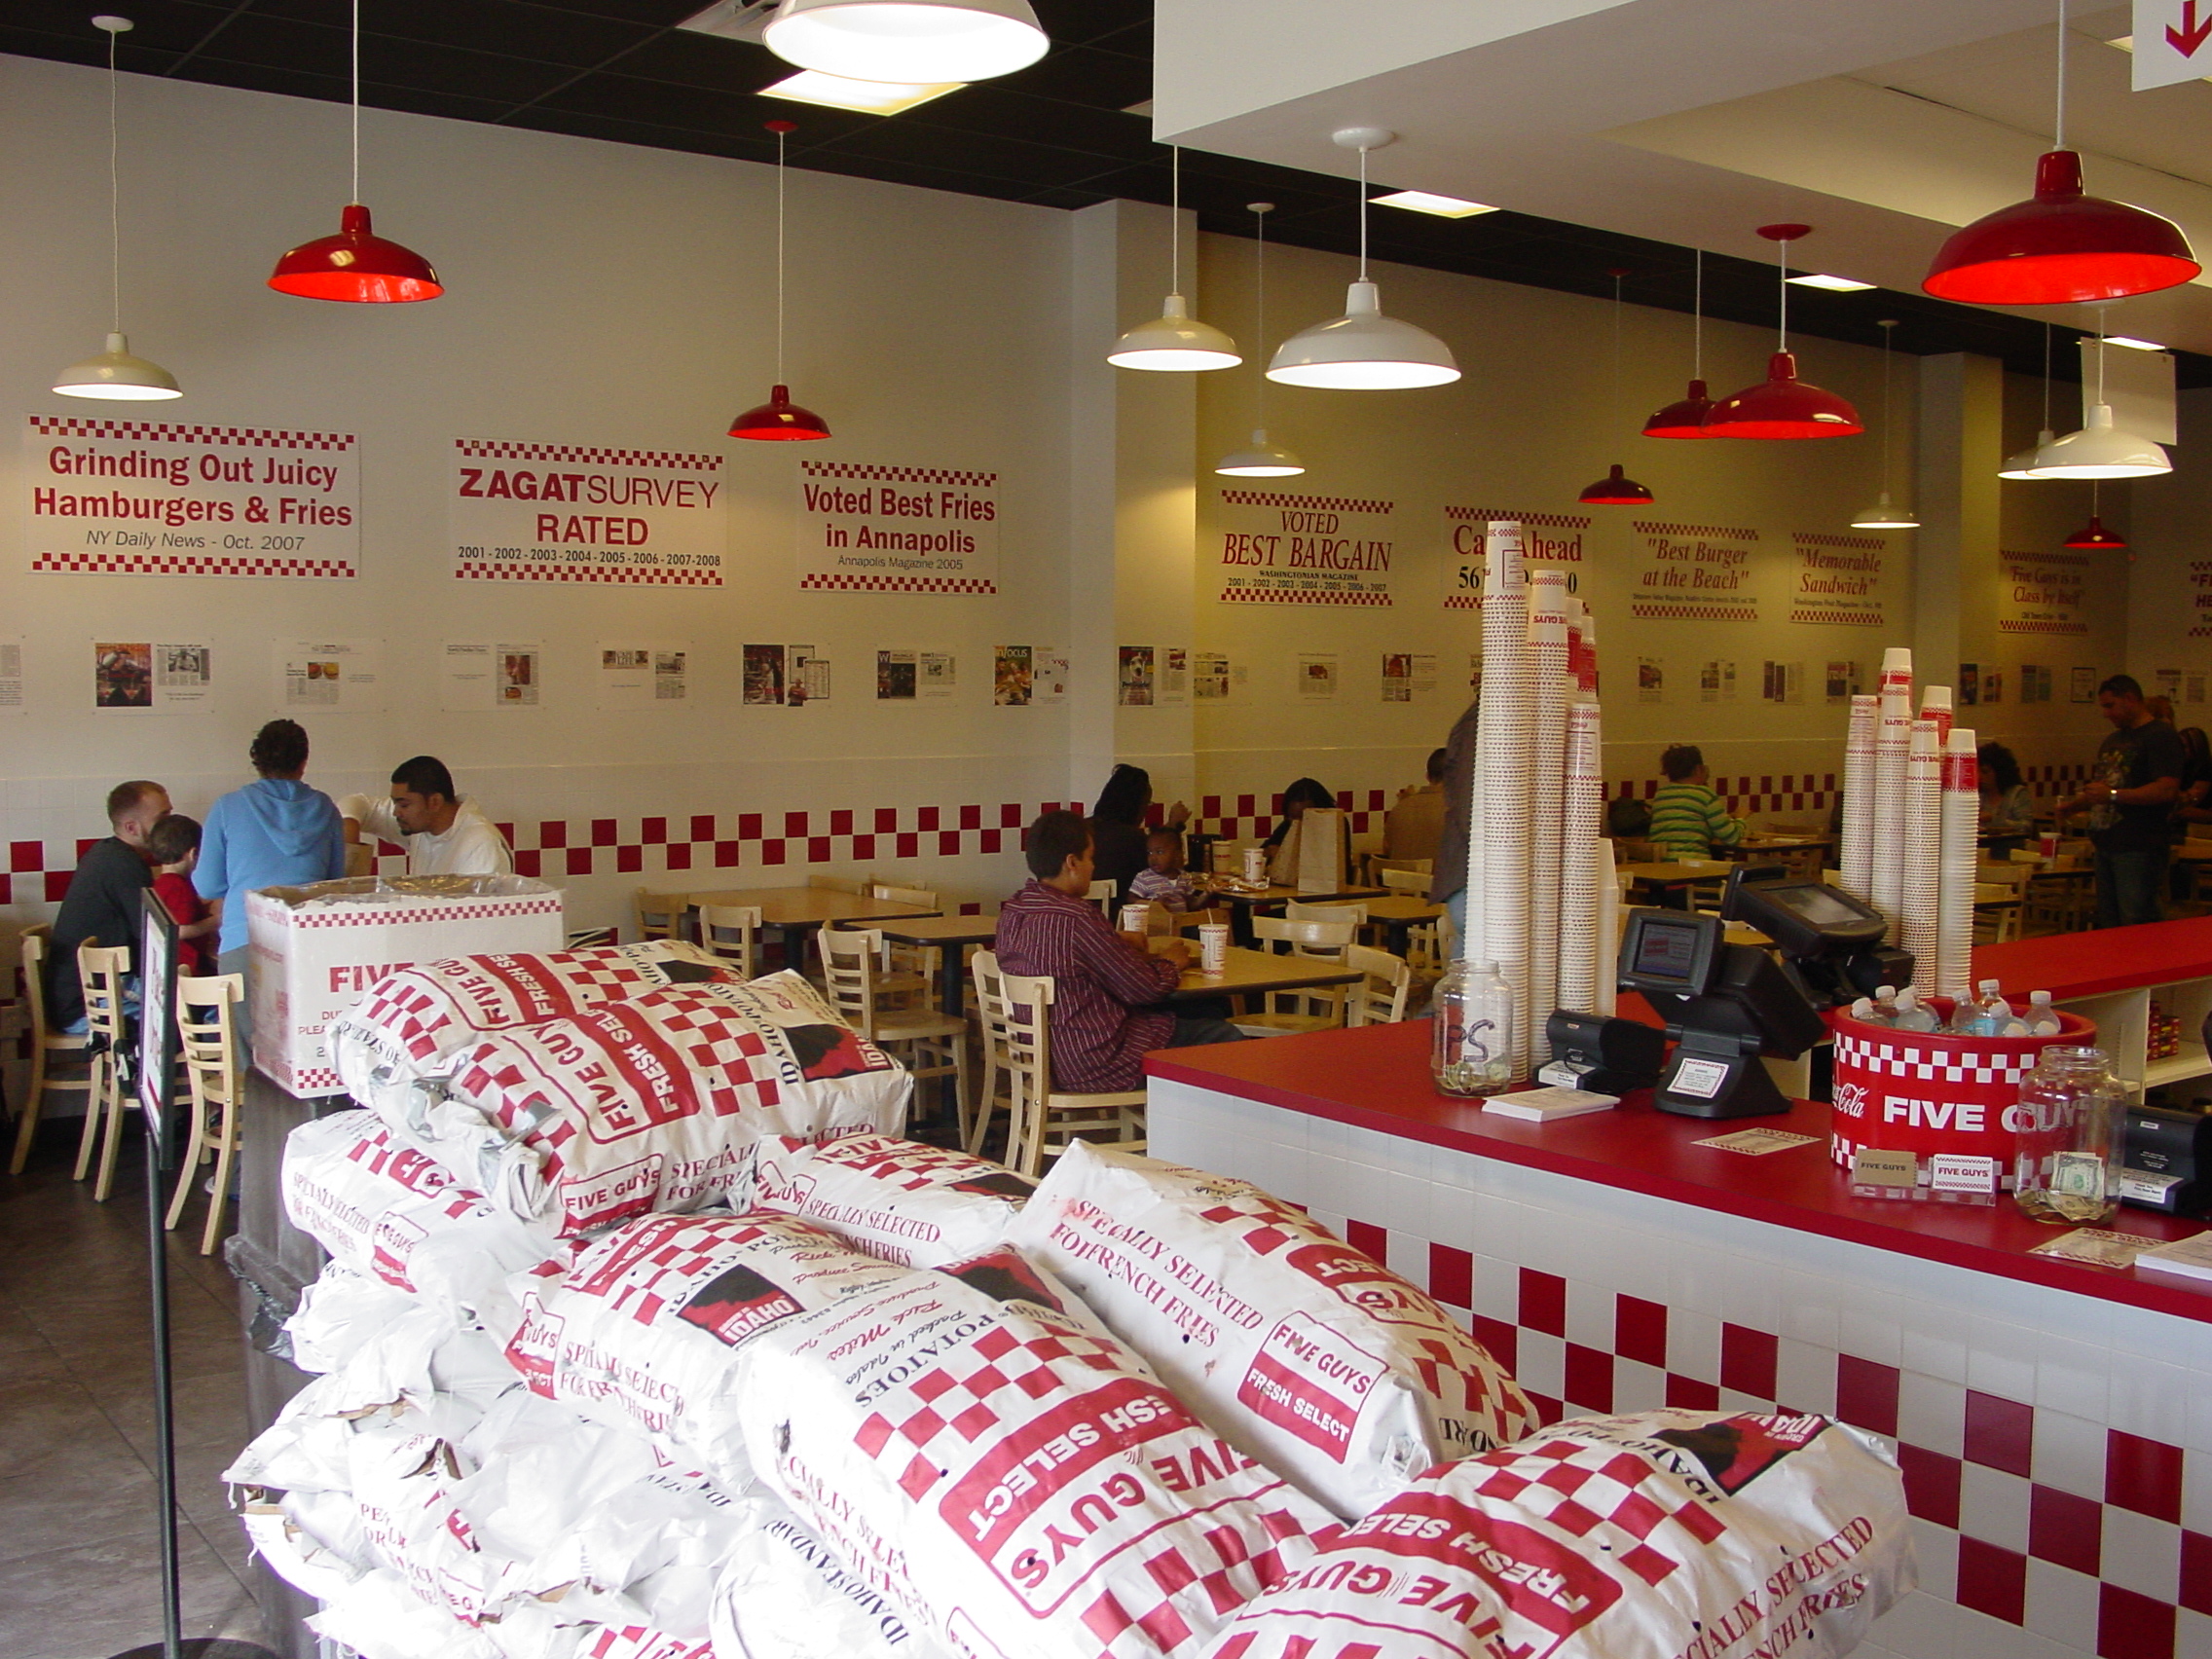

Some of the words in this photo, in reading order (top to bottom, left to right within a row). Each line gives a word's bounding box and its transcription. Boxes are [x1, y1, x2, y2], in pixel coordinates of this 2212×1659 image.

[49, 445, 191, 487] Grinding
[199, 454, 254, 484] Out
[262, 458, 339, 493] Juicy
[33, 487, 236, 527] Hamburgers
[243, 495, 270, 524] &
[278, 497, 352, 527] Fries
[802, 483, 872, 516] Voted
[880, 488, 934, 519] Best
[940, 491, 996, 522] Fries
[86, 530, 111, 546] NY
[115, 531, 156, 550] Daily
[161, 533, 206, 548] News
[222, 535, 254, 550] Oct.
[261, 535, 306, 551] 2007
[536, 513, 649, 546] RATED
[826, 523, 849, 548] in
[855, 525, 977, 557] Annapolis
[1280, 510, 1340, 535] VOTED
[1453, 524, 1487, 555] Ca
[458, 546, 485, 559] 2001
[494, 547, 522, 560] 2002
[531, 548, 558, 561] 2003
[566, 549, 592, 562] 2004
[599, 551, 626, 563] 2005
[633, 552, 659, 565] 2006
[837, 554, 886, 568] Annapolis
[888, 556, 935, 571] Magazine
[937, 558, 964, 570] 2005
[1222, 533, 1282, 567] BEST
[1288, 536, 1393, 571] BARGAIN
[1694, 541, 1749, 569] Burger
[1641, 570, 1659, 587] at
[1663, 566, 1687, 588] the
[329, 962, 415, 993] FIV
[505, 963, 557, 1016] FRESH
[458, 976, 510, 1024] FIVE
[527, 1022, 584, 1065] GUY
[758, 1023, 799, 1085] IDAHO
[574, 1061, 638, 1131] FIVE
[623, 1043, 681, 1114] FRESH
[1883, 1094, 1986, 1132] FIVE
[1861, 1161, 1880, 1170] FIVE
[1937, 1166, 1960, 1176] FIVE
[1961, 1168, 1990, 1178] GUYS
[565, 1187, 608, 1212] FIVE
[866, 1208, 941, 1243] SELECTED
[875, 1242, 913, 1268] FRIES
[793, 1267, 851, 1284] Produce
[875, 1280, 941, 1307] Produce
[1086, 1242, 1167, 1306] FRENCH
[1160, 1295, 1221, 1348] FRIES
[1163, 1254, 1265, 1331] SELECTED
[722, 1298, 796, 1342] IDAHO
[889, 1299, 944, 1326] Rick
[826, 1323, 891, 1361] Miles
[854, 1312, 996, 1409] POTATOES
[1272, 1322, 1321, 1363] FIVE
[1317, 1351, 1374, 1396] GUYS
[1100, 1394, 1173, 1434] ESH
[1246, 1367, 1291, 1408] FRESH
[1292, 1397, 1351, 1444] SELECT
[968, 1421, 1101, 1542] SELECT
[1150, 1439, 1261, 1493] IVE
[1618, 1439, 1723, 1505] IDAHO
[1011, 1472, 1147, 1589] GUYS
[1448, 1531, 1592, 1614] FRESH
[1765, 1515, 1875, 1607] SELECTED
[844, 1582, 910, 1645] IDAHO
